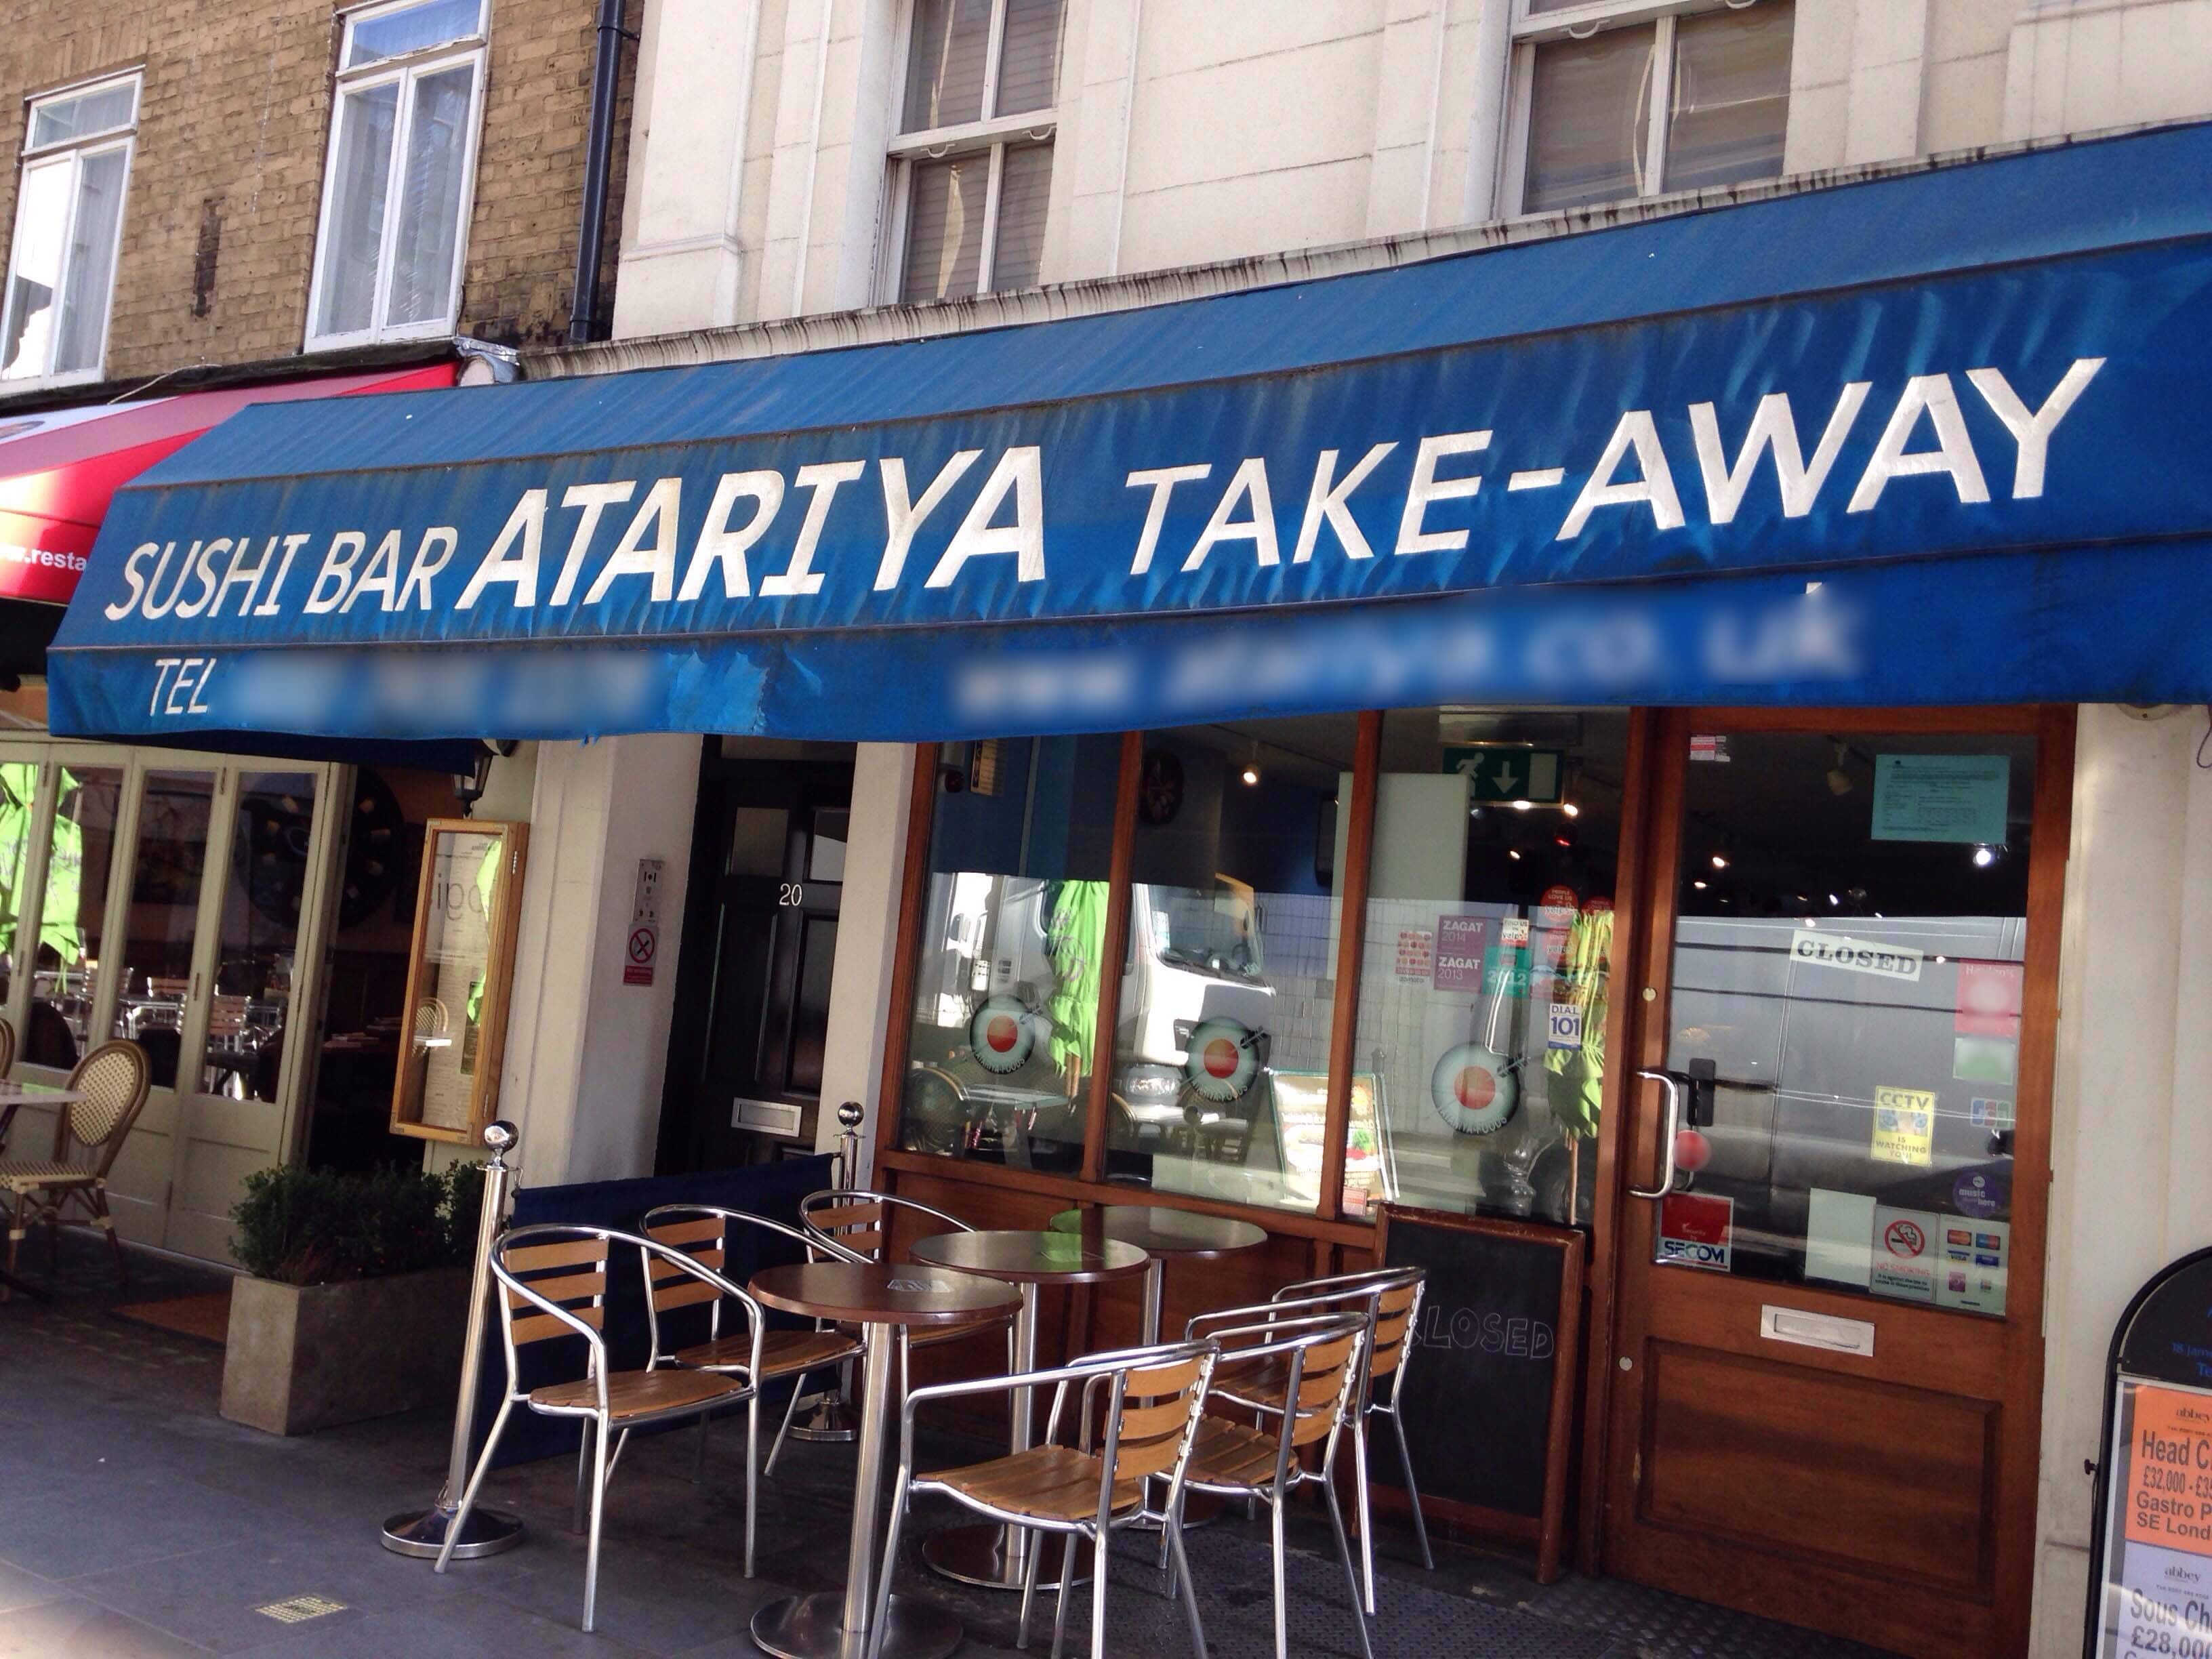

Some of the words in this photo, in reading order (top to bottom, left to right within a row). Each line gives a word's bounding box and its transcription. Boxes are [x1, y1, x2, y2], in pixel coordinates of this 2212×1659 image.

[105, 534, 310, 621] SUSHI
[304, 527, 457, 613] BAR
[1125, 357, 2106, 575] TAKE-AWAY
[149, 657, 217, 716] TEL
[779, 883, 802, 906] 20
[1443, 920, 1484, 933] ZAGAT
[1438, 956, 1481, 970] ZAGAT
[1797, 940, 1917, 975] CLOSED
[1437, 968, 1464, 980] 2013
[1551, 1004, 1580, 1015] DIAL
[1550, 1016, 1580, 1036] 101
[1880, 1092, 1929, 1110] CCTV
[1875, 1140, 1927, 1154] WATCHING
[1959, 1187, 1986, 1197] music
[1664, 1241, 1725, 1264] SECOM
[1412, 1305, 1555, 1359] LOSED
[2176, 1408, 2212, 1423] abbey
[2142, 1429, 2190, 1467] Head
[2196, 1439, 2212, 1471] C
[2143, 1465, 2186, 1495] £32,000
[2136, 1491, 2194, 1519] Gastro
[2137, 1511, 2160, 1530] SE
[2167, 1517, 2212, 1541] Lond
[2165, 1566, 2202, 1583] abbey
[2131, 1588, 2178, 1626] Sous
[2185, 1600, 2212, 1634] Ch
